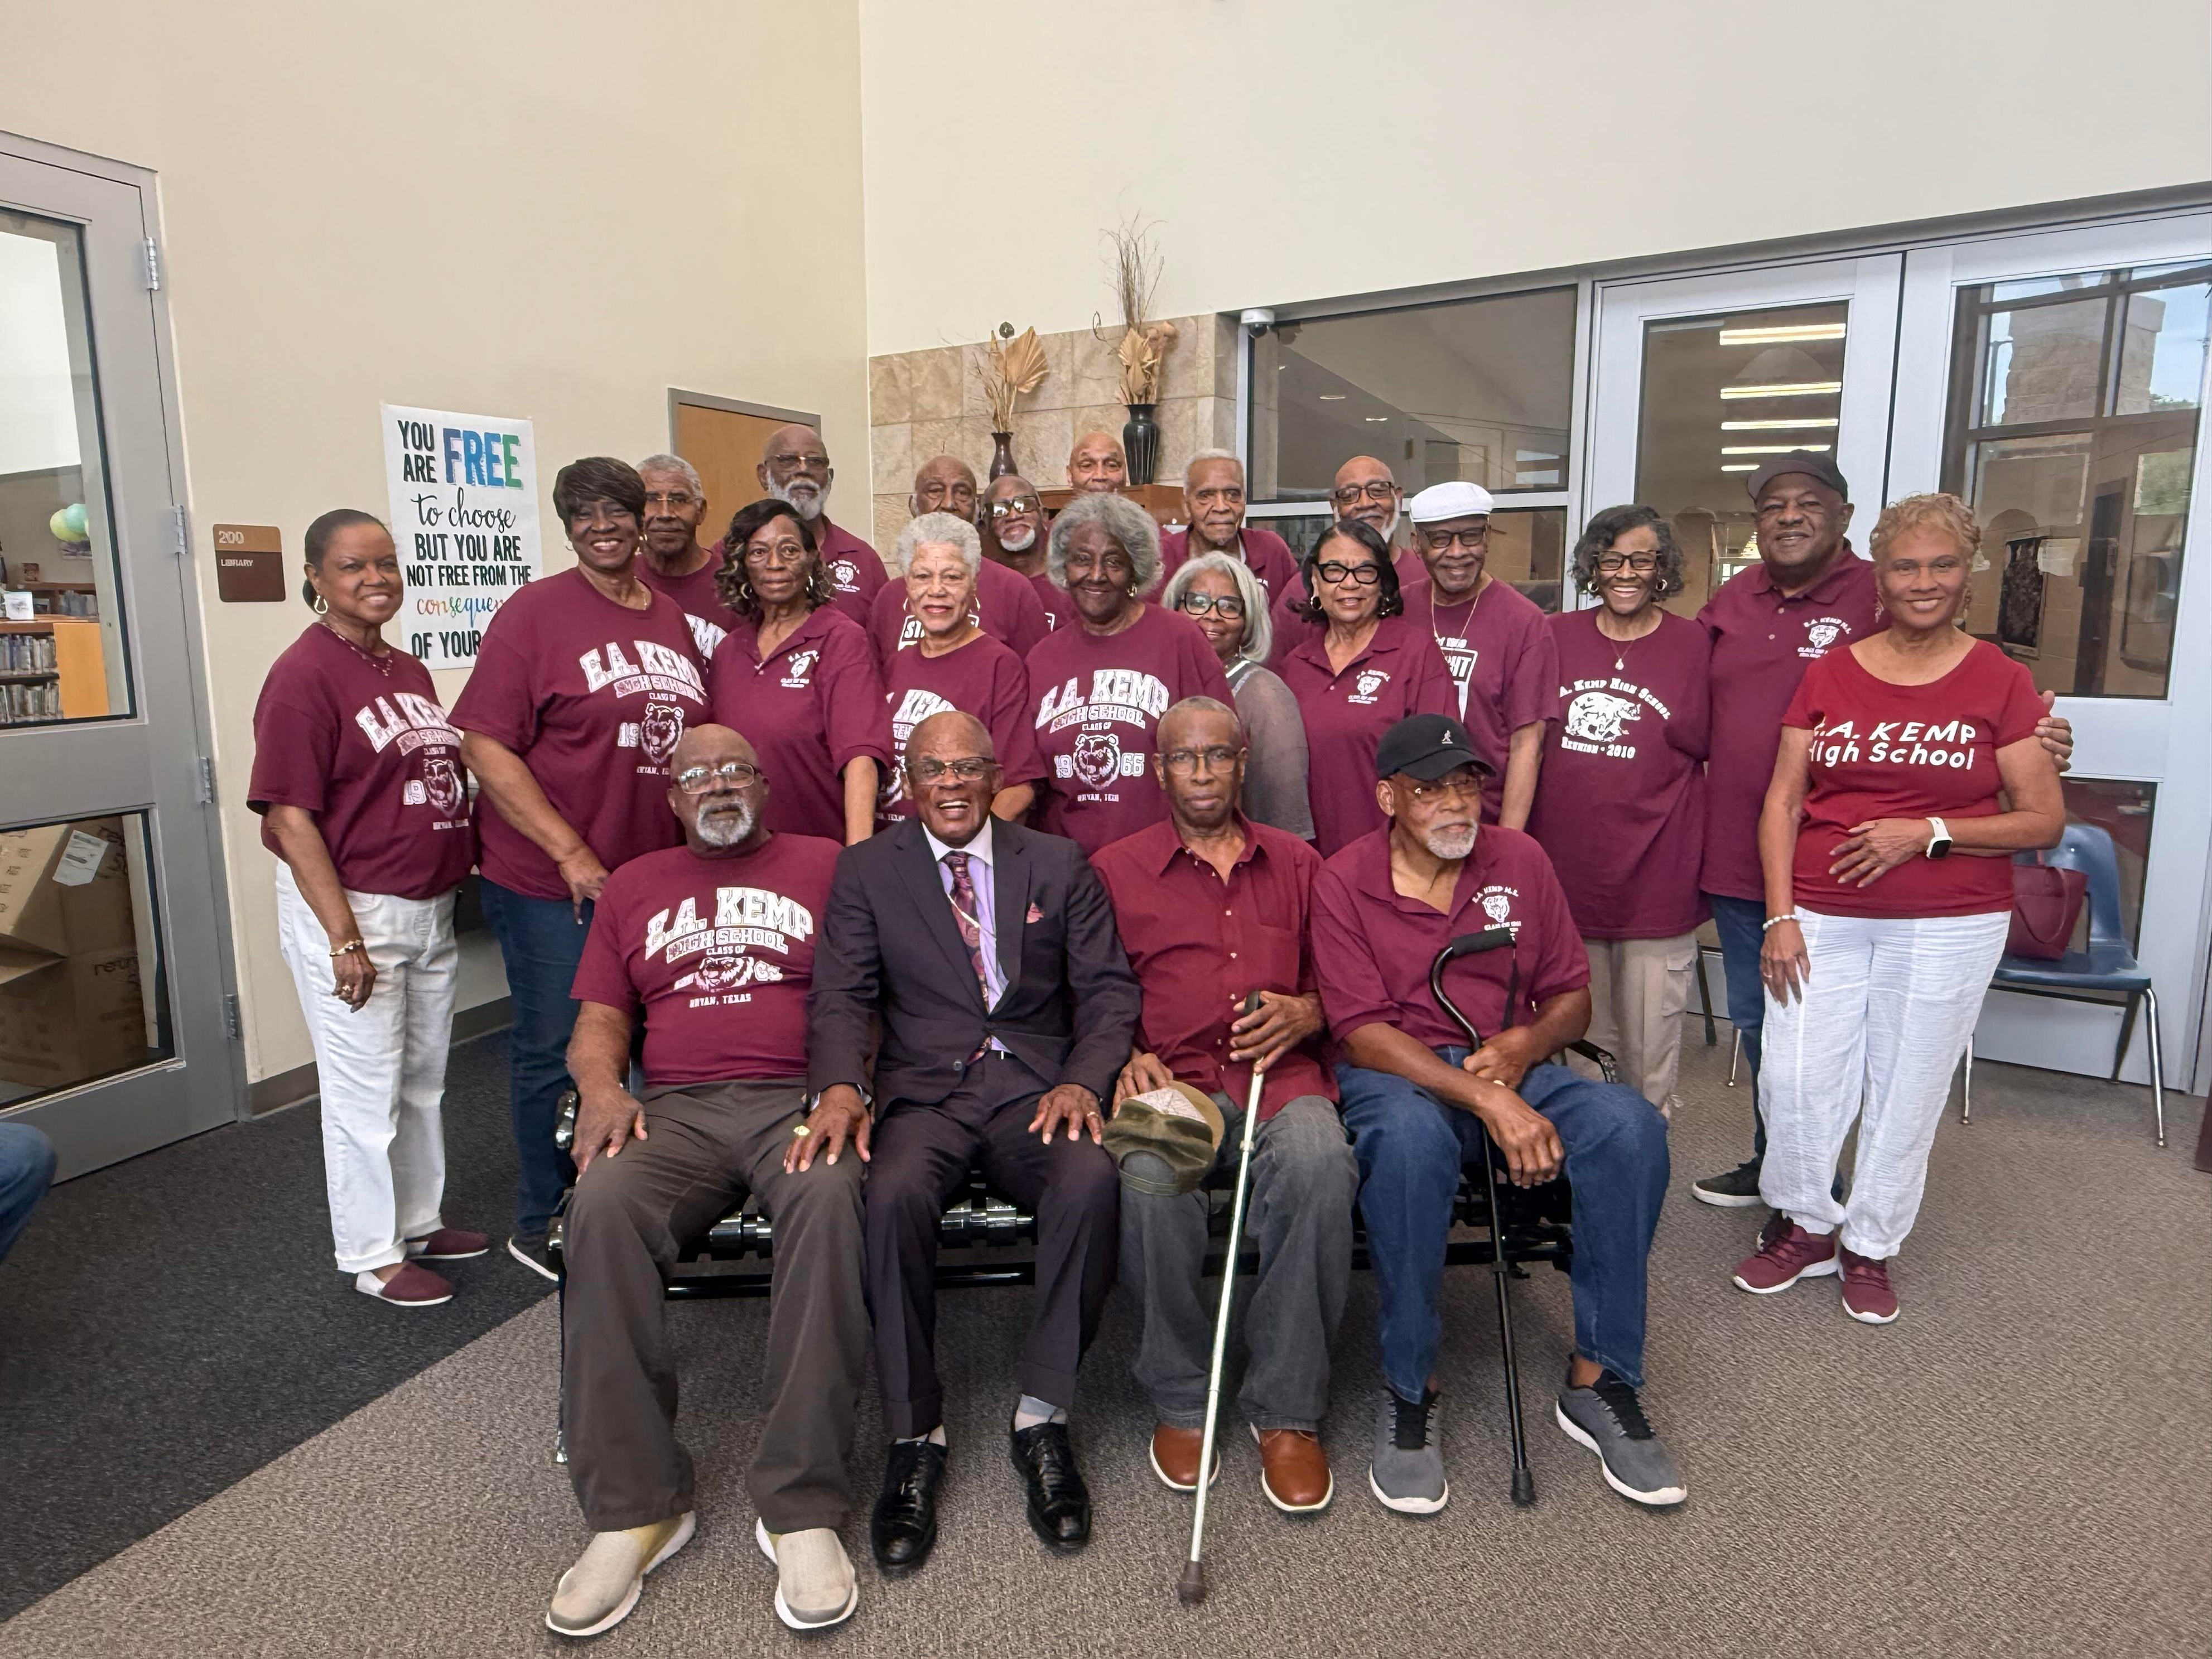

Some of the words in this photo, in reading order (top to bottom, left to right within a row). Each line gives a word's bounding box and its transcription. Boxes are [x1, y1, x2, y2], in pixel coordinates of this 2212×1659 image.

[397, 419, 435, 452] YOU
[403, 453, 438, 484] ARE
[443, 427, 524, 490] FREE
[411, 493, 444, 526] to
[448, 486, 517, 533] choose
[218, 531, 244, 544] 200
[415, 533, 449, 561] BUT
[454, 534, 488, 562] YOU
[493, 536, 523, 562] ARE
[406, 565, 434, 587] NOT
[438, 565, 470, 586] FREE
[473, 565, 507, 586] FROM
[509, 565, 532, 586] THE
[411, 632, 433, 659] OF
[438, 630, 482, 658] YOUR
[1088, 669, 1170, 720] KEMP
[1088, 704, 1146, 730] SCHOOL
[1868, 720, 1977, 745] KEMP
[1120, 752, 1145, 777] 66
[1606, 743, 1636, 760] 2010
[1868, 742, 1975, 770] School
[715, 886, 814, 942] KEMP
[706, 946, 734, 956] CLASS
[735, 945, 746, 954] OF
[715, 927, 789, 955] SCHOOL
[722, 993, 751, 1005] TEXAS
